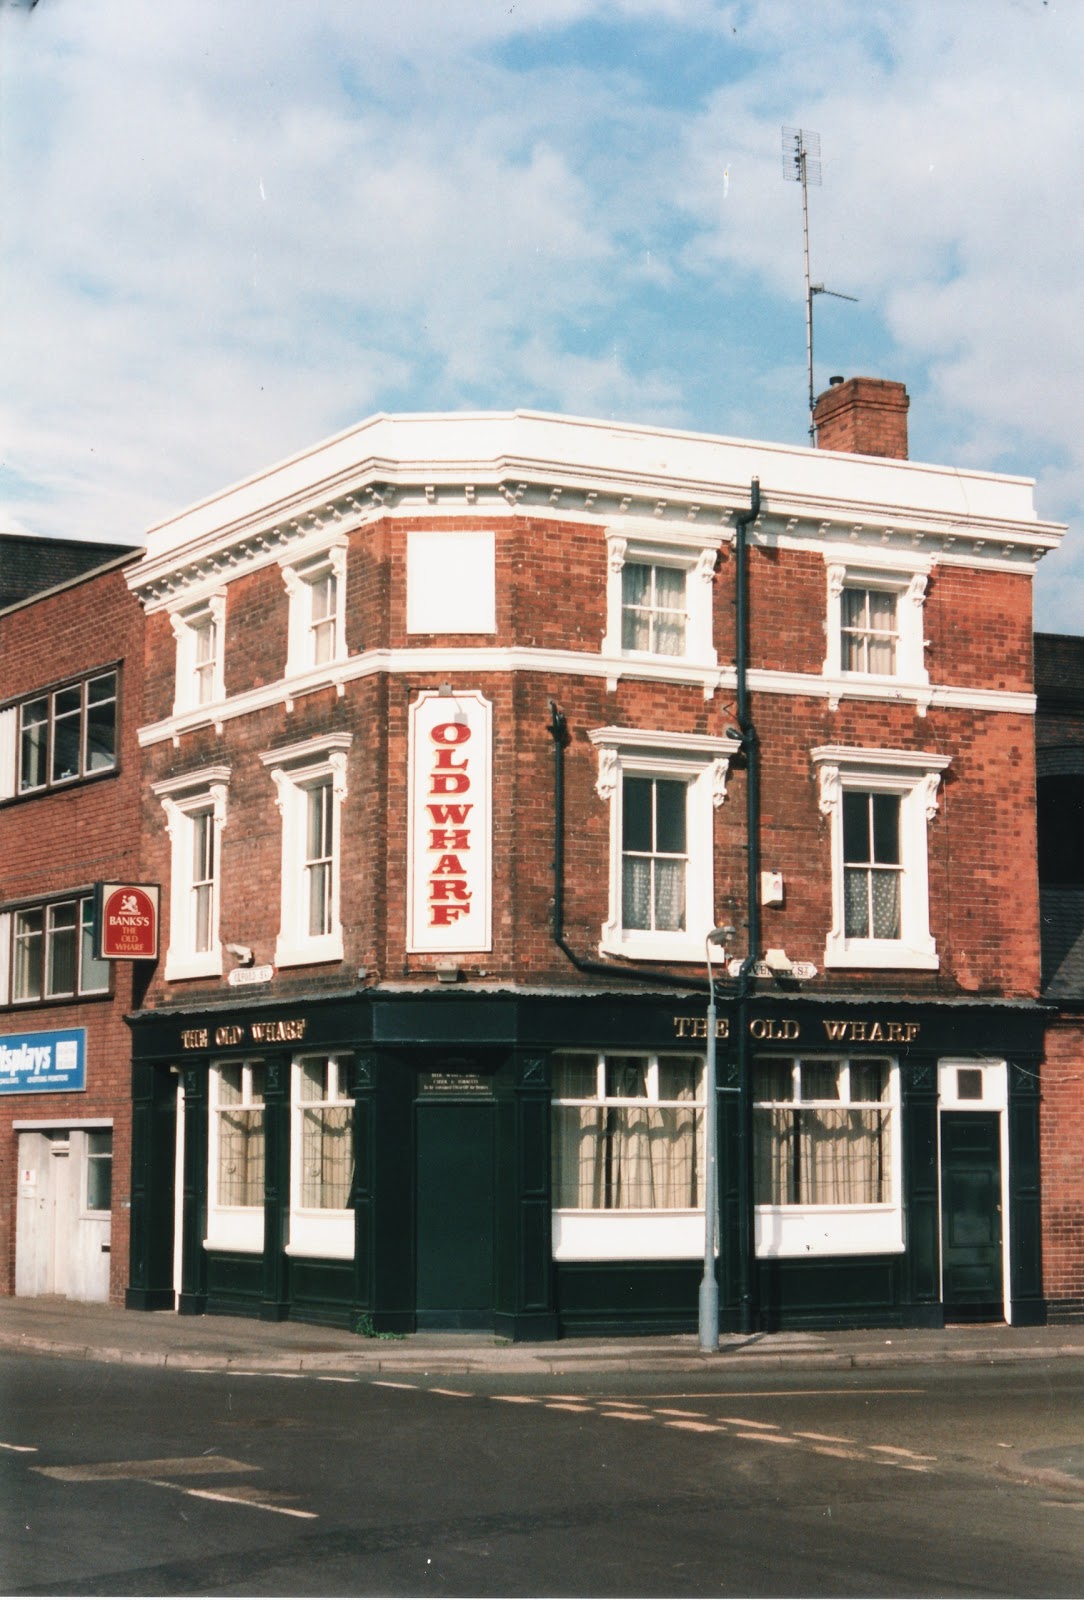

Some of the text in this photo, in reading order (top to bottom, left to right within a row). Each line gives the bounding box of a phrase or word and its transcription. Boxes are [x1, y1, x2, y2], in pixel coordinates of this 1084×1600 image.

[426, 722, 474, 927] OLD WHARF
[109, 916, 150, 927] BANKS'S
[121, 935, 139, 943] OLD
[122, 927, 137, 935] THE
[115, 943, 144, 951] WHARF
[181, 1018, 306, 1049] THE OLD WHARF
[673, 1016, 921, 1042] THE OLD WHARF
[0, 1043, 51, 1077] isplays
